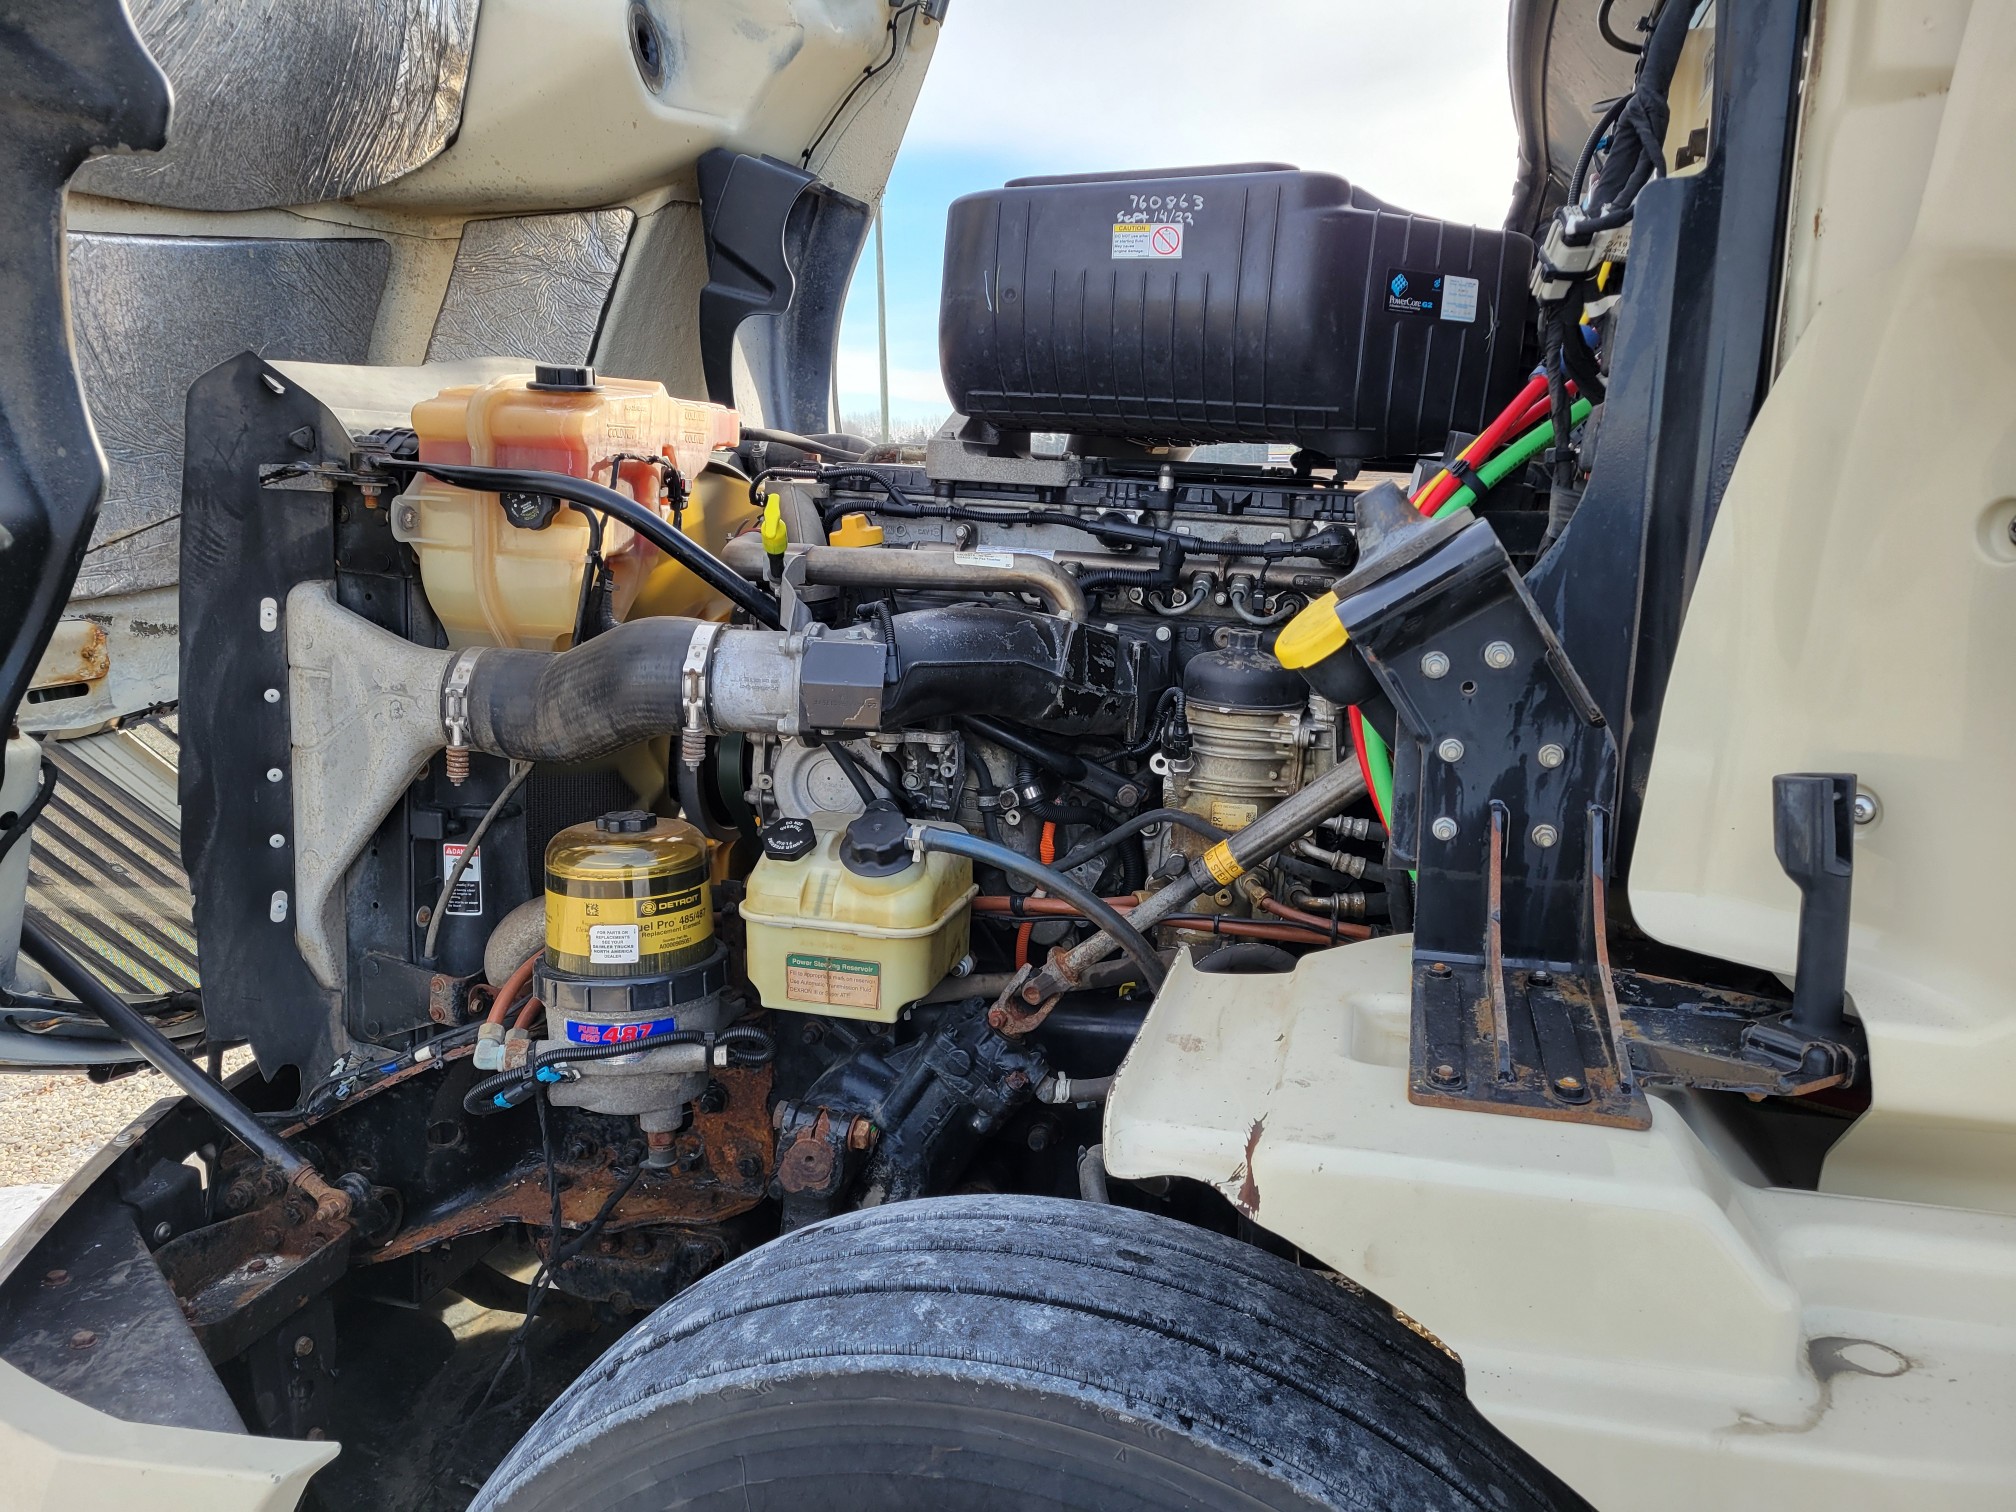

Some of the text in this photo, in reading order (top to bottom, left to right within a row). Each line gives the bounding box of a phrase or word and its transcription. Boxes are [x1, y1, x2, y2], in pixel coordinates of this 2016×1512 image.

[1129, 193, 1204, 211] 760863
[1116, 210, 1149, 223] Sept
[1389, 294, 1421, 307] PowerCore
[1421, 301, 1433, 309] G2
[1210, 863, 1229, 881] STEP
[1226, 861, 1239, 872] NO
[658, 893, 699, 910] DETROIT
[656, 920, 675, 930] Pro
[678, 907, 706, 925] 485/487
[641, 927, 682, 938] Replacement
[682, 919, 701, 931] Element
[792, 958, 812, 967] Power
[841, 963, 874, 973] Reservoir
[789, 986, 812, 995] DEXRON
[800, 979, 825, 988] Automatic
[577, 1024, 600, 1035] FUEL
[580, 1023, 654, 1044] PRO 487
